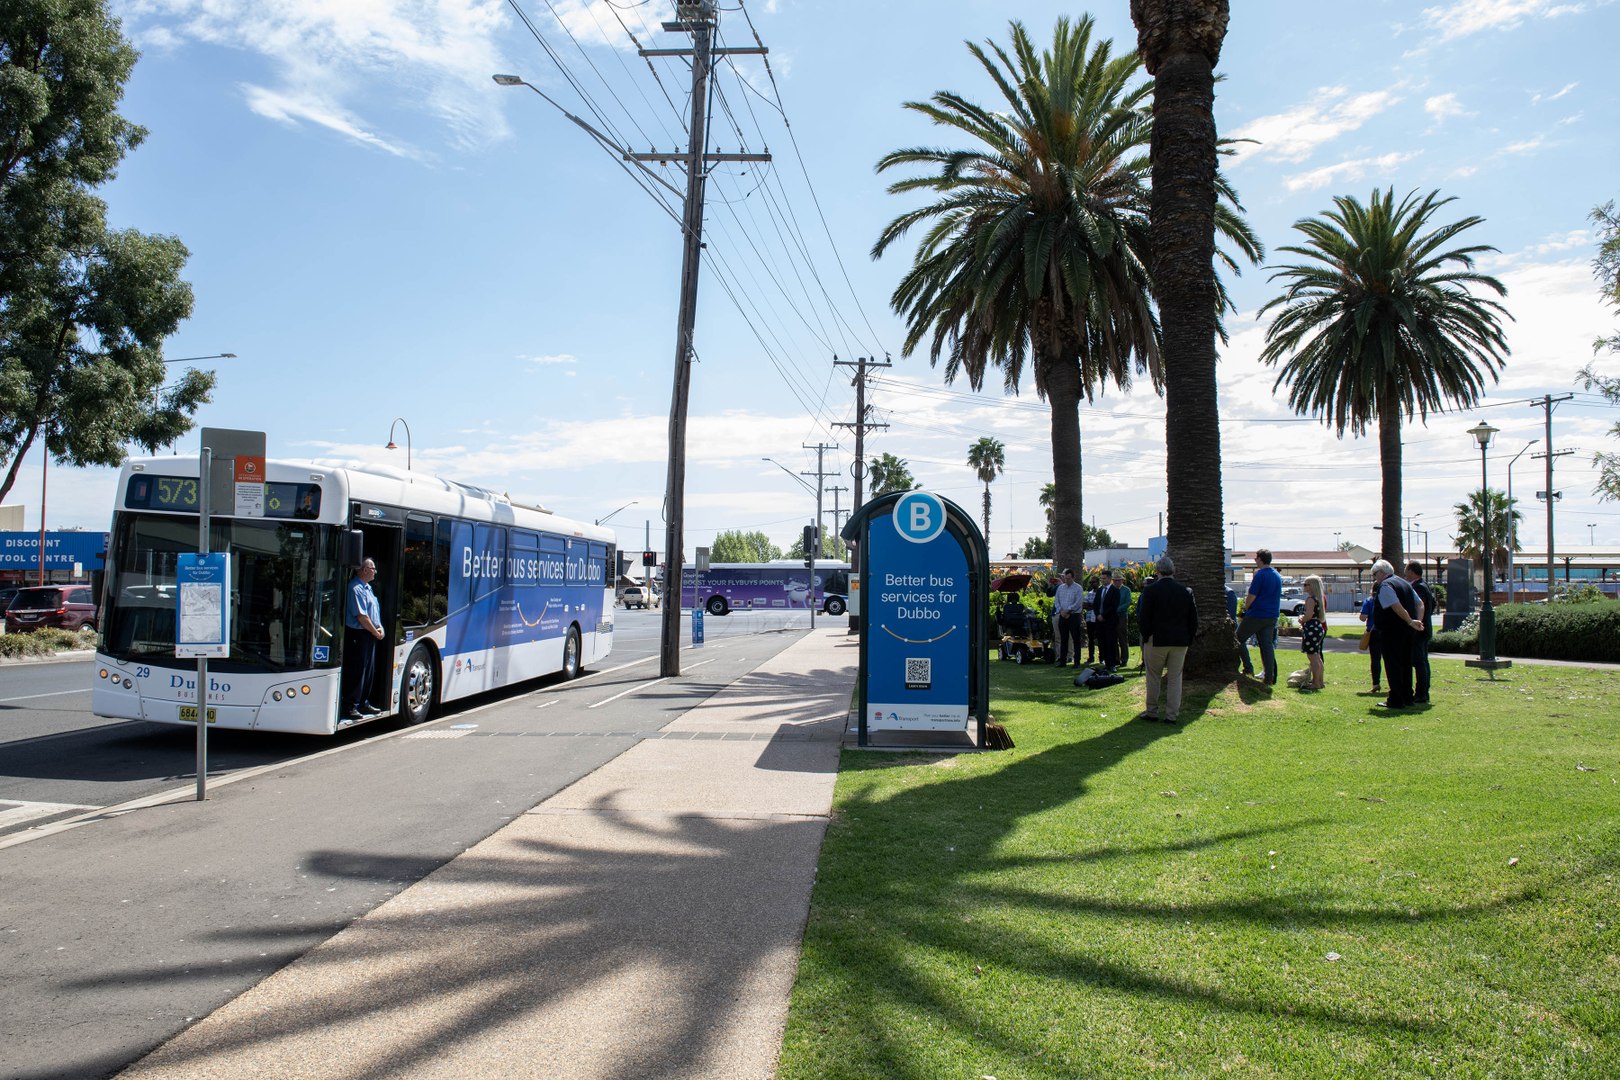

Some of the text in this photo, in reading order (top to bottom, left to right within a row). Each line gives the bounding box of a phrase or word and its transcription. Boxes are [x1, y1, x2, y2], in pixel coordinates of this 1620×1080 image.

[158, 478, 197, 505] 573
[910, 502, 931, 531] B
[0, 554, 26, 562] TOOL
[462, 546, 601, 581] Better bus services for Dubbo
[885, 573, 954, 587] Better bus
[881, 590, 958, 604] services for
[898, 606, 940, 620] Dubbo
[136, 666, 150, 678] 29
[170, 674, 231, 692] Dubo
